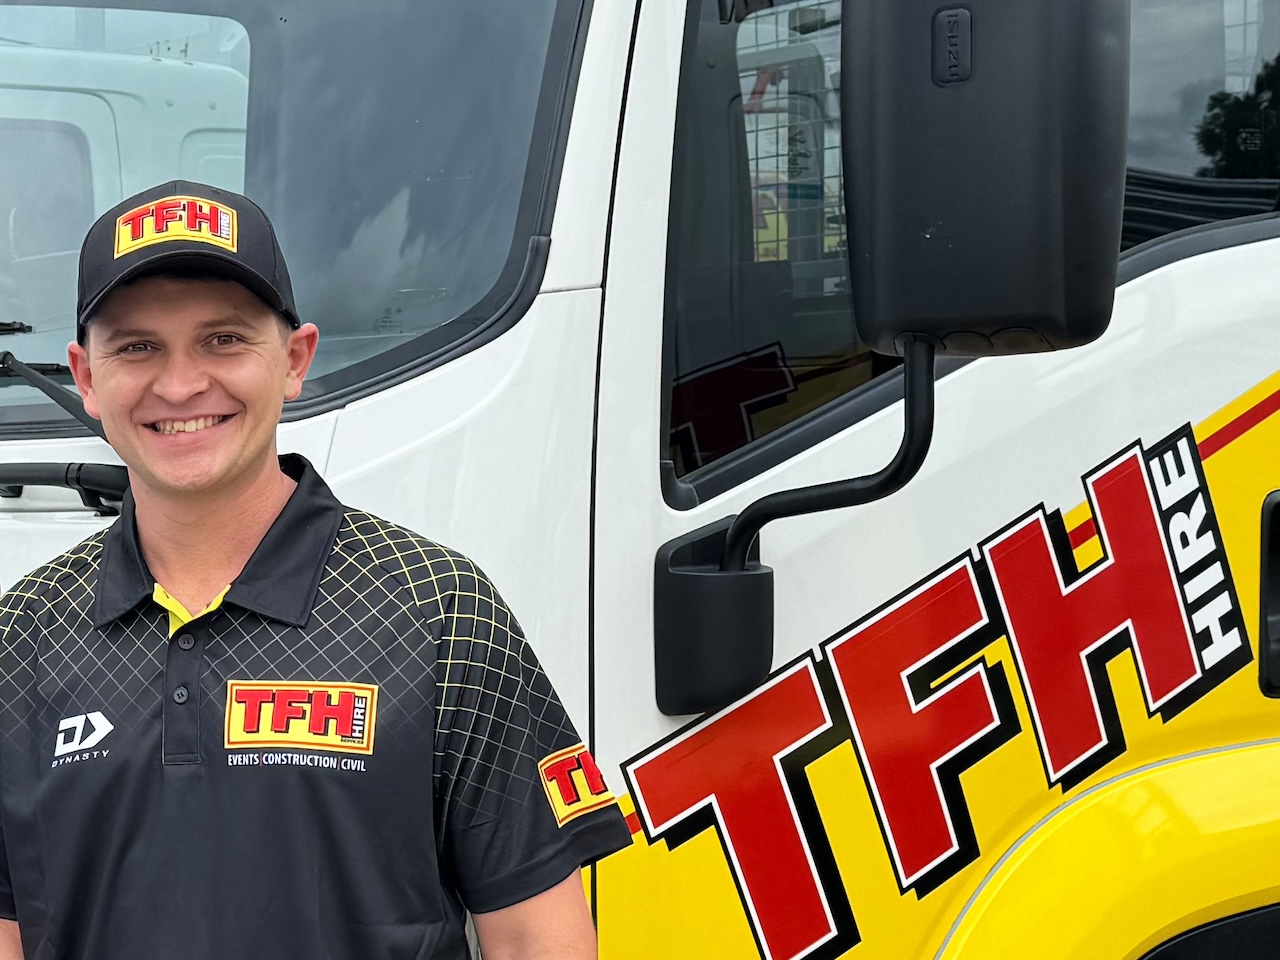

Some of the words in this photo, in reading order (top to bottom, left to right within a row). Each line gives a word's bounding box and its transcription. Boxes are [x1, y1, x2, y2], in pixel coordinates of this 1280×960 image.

[121, 200, 220, 242] TFH
[1149, 436, 1245, 672] HIRE
[235, 689, 356, 737] TFH
[351, 696, 367, 738] HIRE
[51, 749, 110, 768] DYNASTY
[228, 753, 260, 766] EVENTS
[262, 753, 338, 769] CONSTRUCTION
[341, 758, 367, 772] CIVIL
